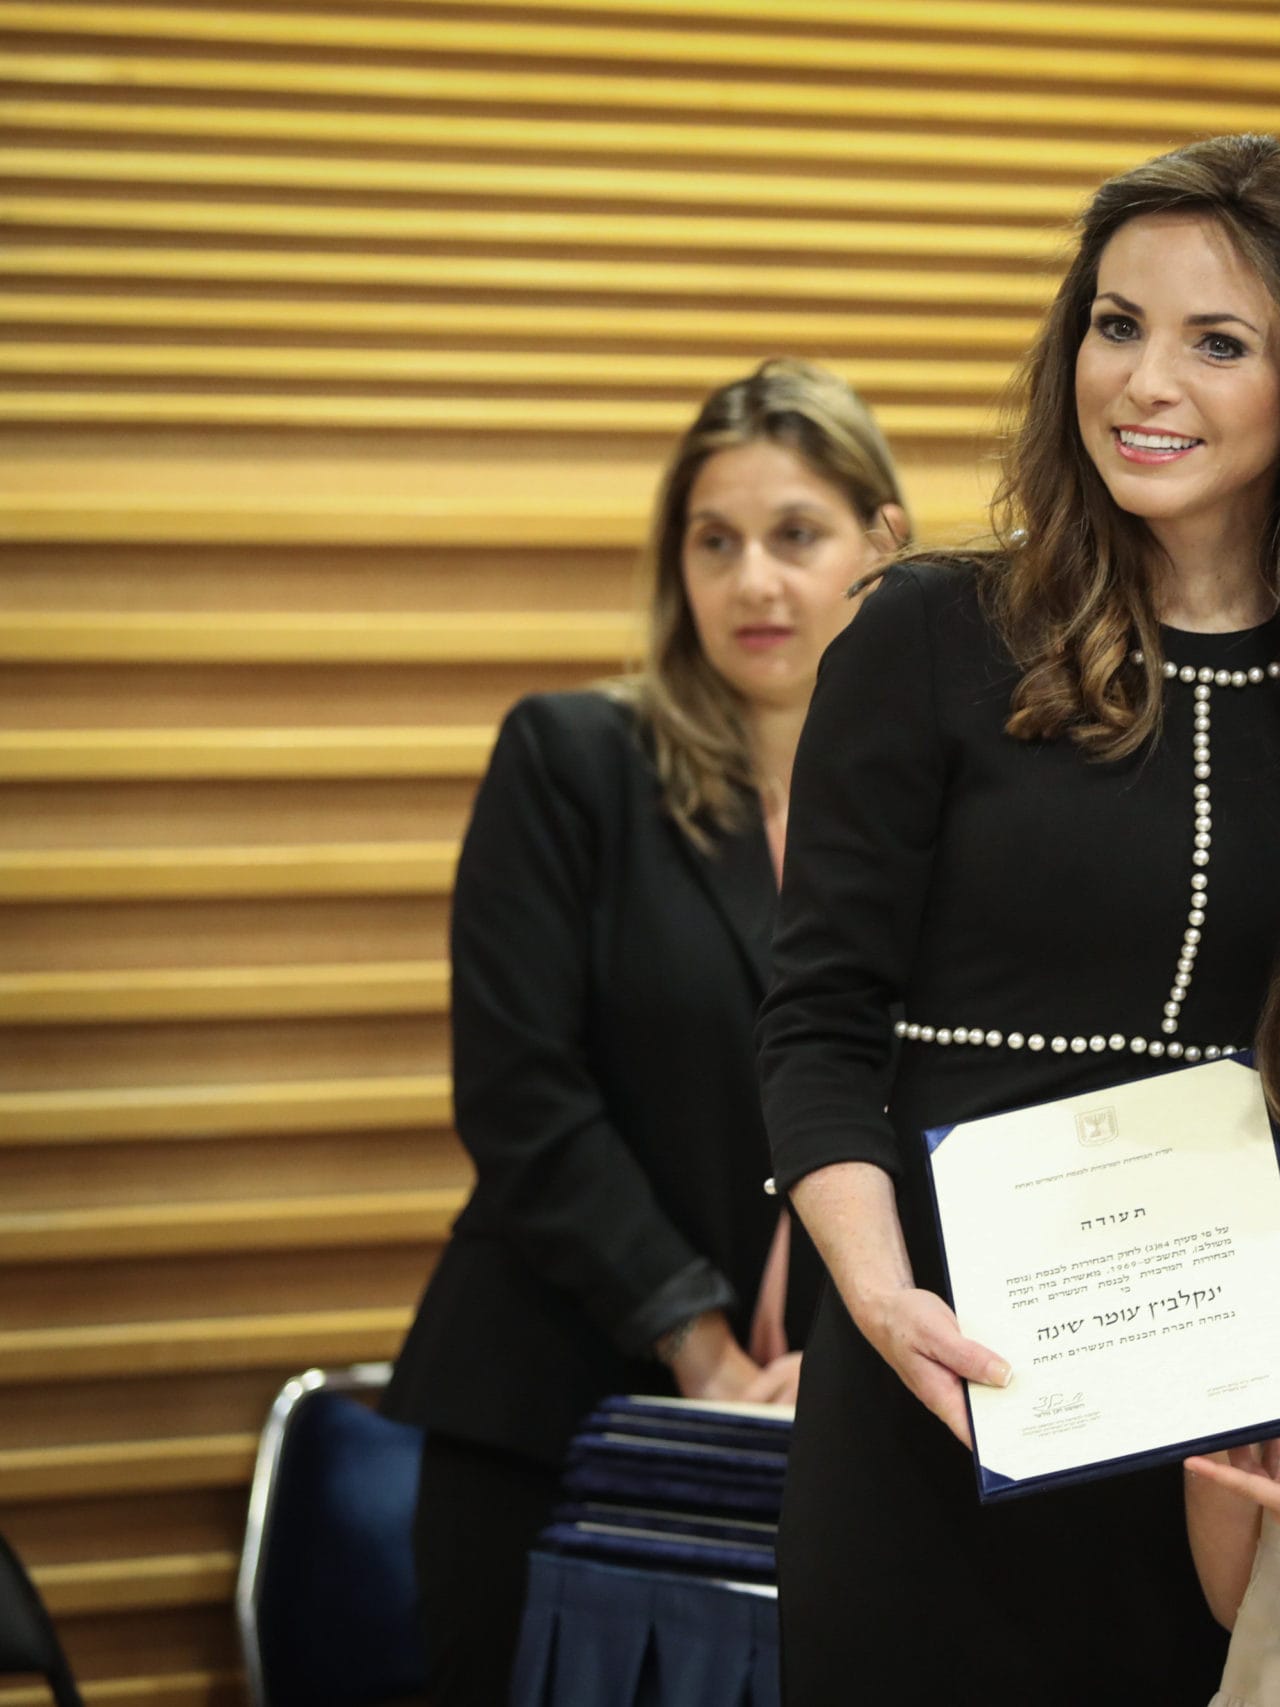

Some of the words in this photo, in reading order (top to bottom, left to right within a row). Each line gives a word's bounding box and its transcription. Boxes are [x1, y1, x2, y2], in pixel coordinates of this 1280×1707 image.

[1081, 1208, 1146, 1231] תעודה
[1215, 1226, 1229, 1234] על
[1174, 1234, 1198, 1246] סעיף
[1071, 1254, 1114, 1270] הבחירות
[1193, 1250, 1235, 1266] הבחירות
[1036, 1264, 1067, 1279] לכנסת
[1063, 1270, 1101, 1285] מאשרת
[1140, 1263, 1183, 1279] המרכזית
[1039, 1281, 1057, 1290] בזה
[1098, 1274, 1130, 1289] לכנסת
[1009, 1286, 1034, 1297] ועדת
[1048, 1286, 1088, 1301] העשרים
[1012, 1297, 1039, 1309] ואחת
[1148, 1286, 1222, 1319] ינקלביץ
[1092, 1306, 1141, 1327] עומר
[1199, 1311, 1236, 1325] נבחרה
[1037, 1319, 1085, 1341] שינה
[1162, 1321, 1193, 1334] חברת
[1119, 1330, 1156, 1344] הכנסת
[1068, 1340, 1114, 1356] העשרים
[1033, 1352, 1063, 1365] ואחת
